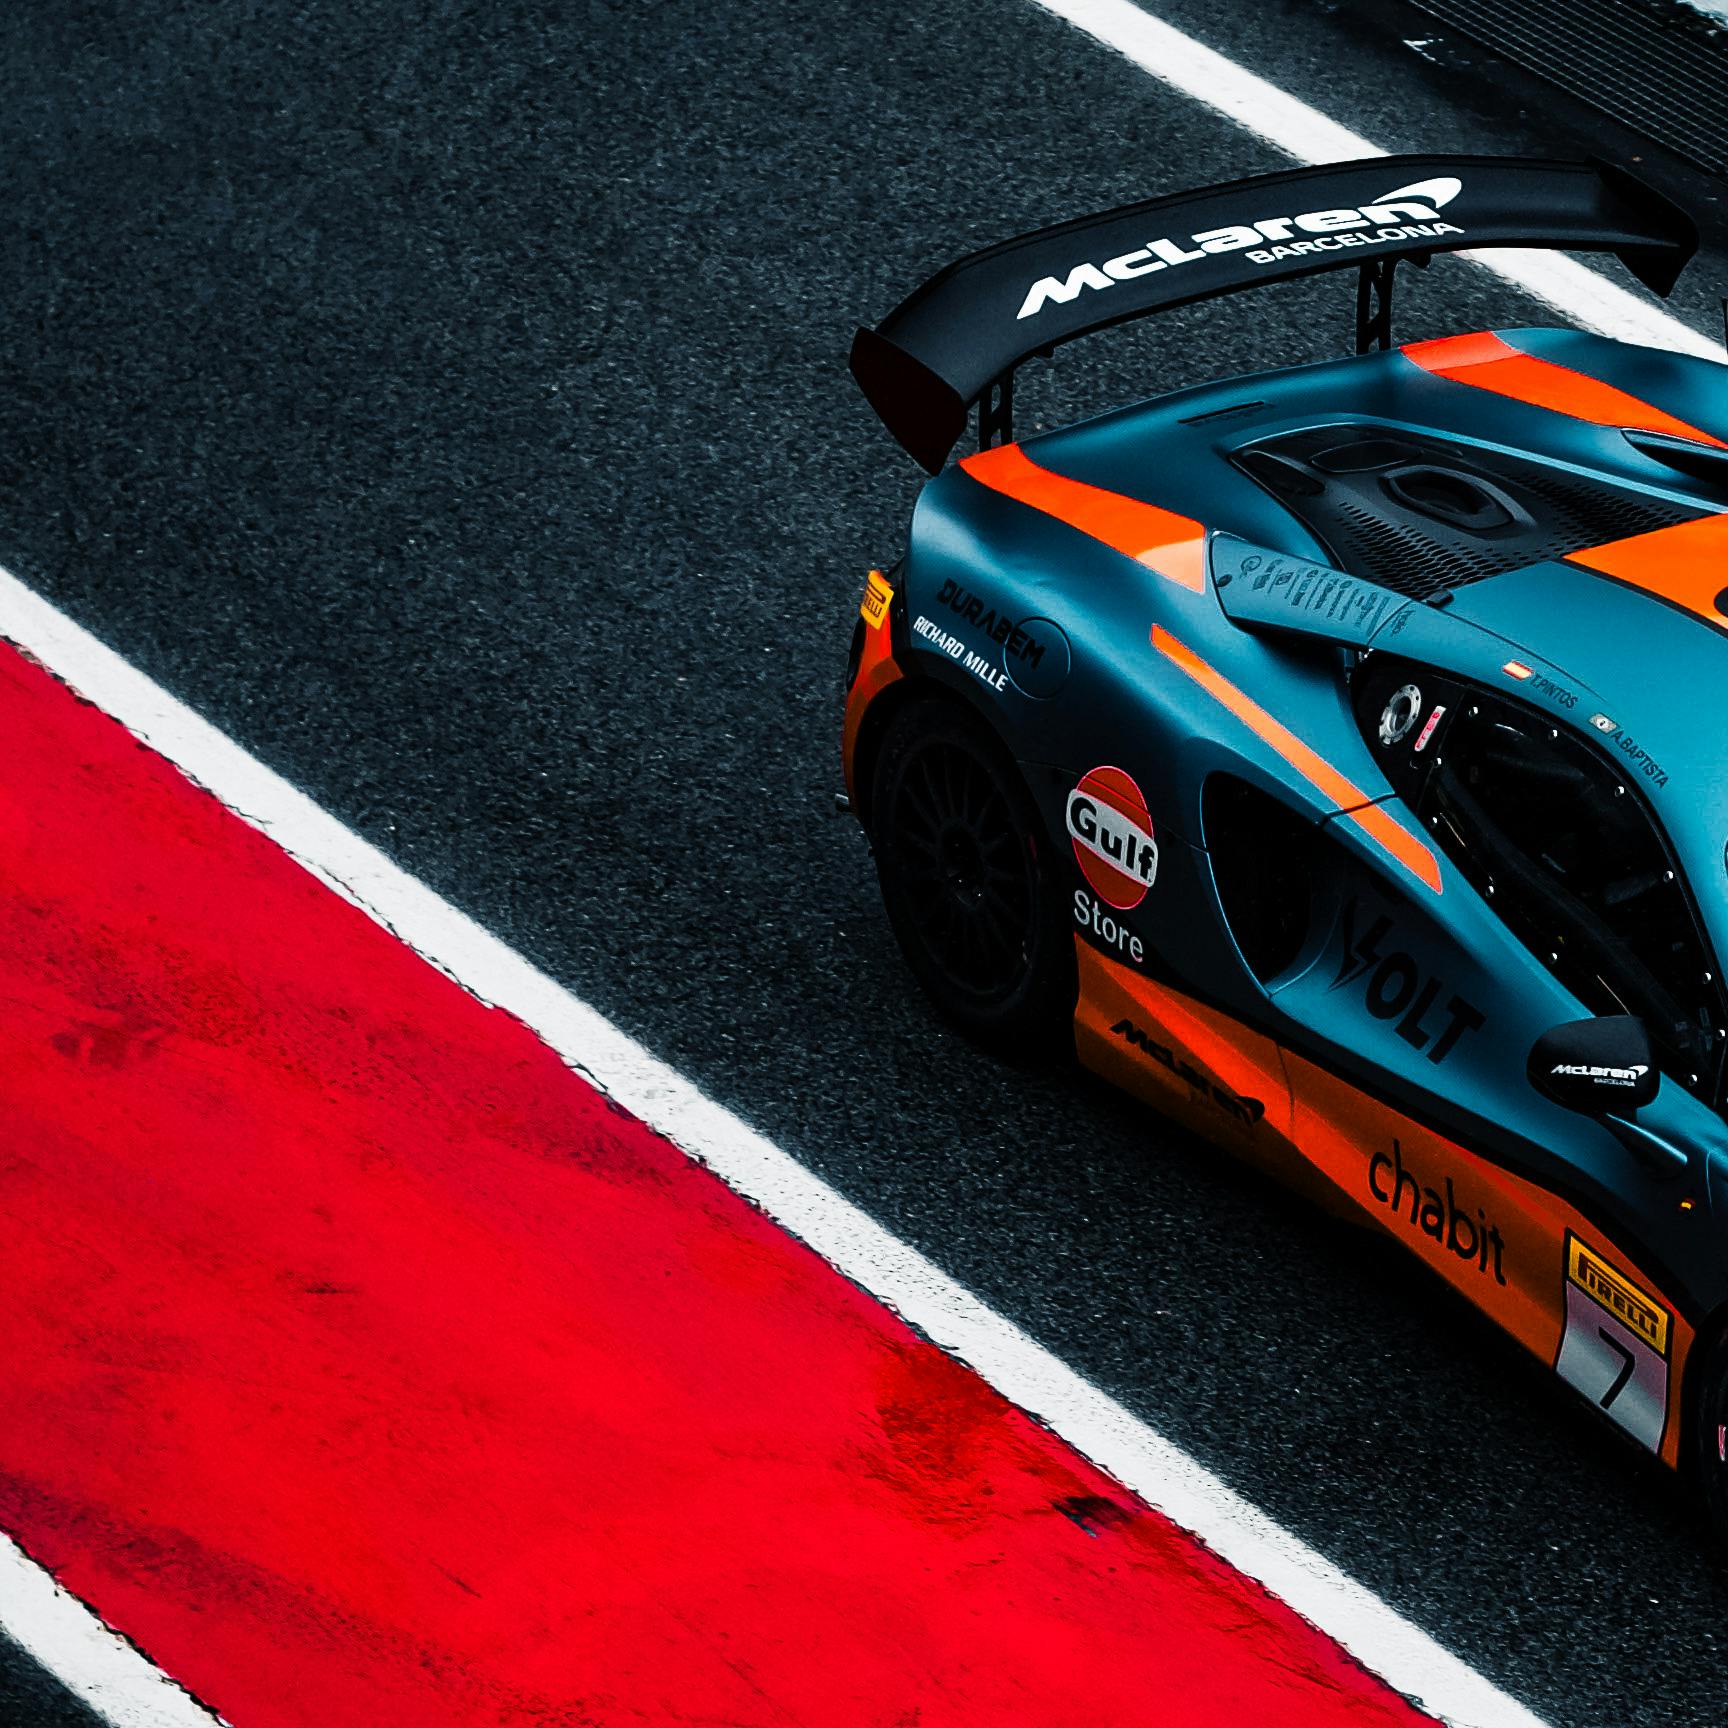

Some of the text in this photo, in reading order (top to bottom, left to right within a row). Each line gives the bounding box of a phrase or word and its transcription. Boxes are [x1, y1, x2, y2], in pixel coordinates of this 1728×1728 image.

[1016, 187, 1450, 320] McLaren
[1246, 221, 1465, 265] BARCELONA
[914, 615, 1009, 692] RICHARD MILLE
[1070, 796, 1157, 883] Gulf
[1074, 890, 1144, 964] Store
[1369, 1138, 1507, 1287] chabit
[1577, 1251, 1659, 1339] PIRELLI
[1599, 1324, 1636, 1410] 7
